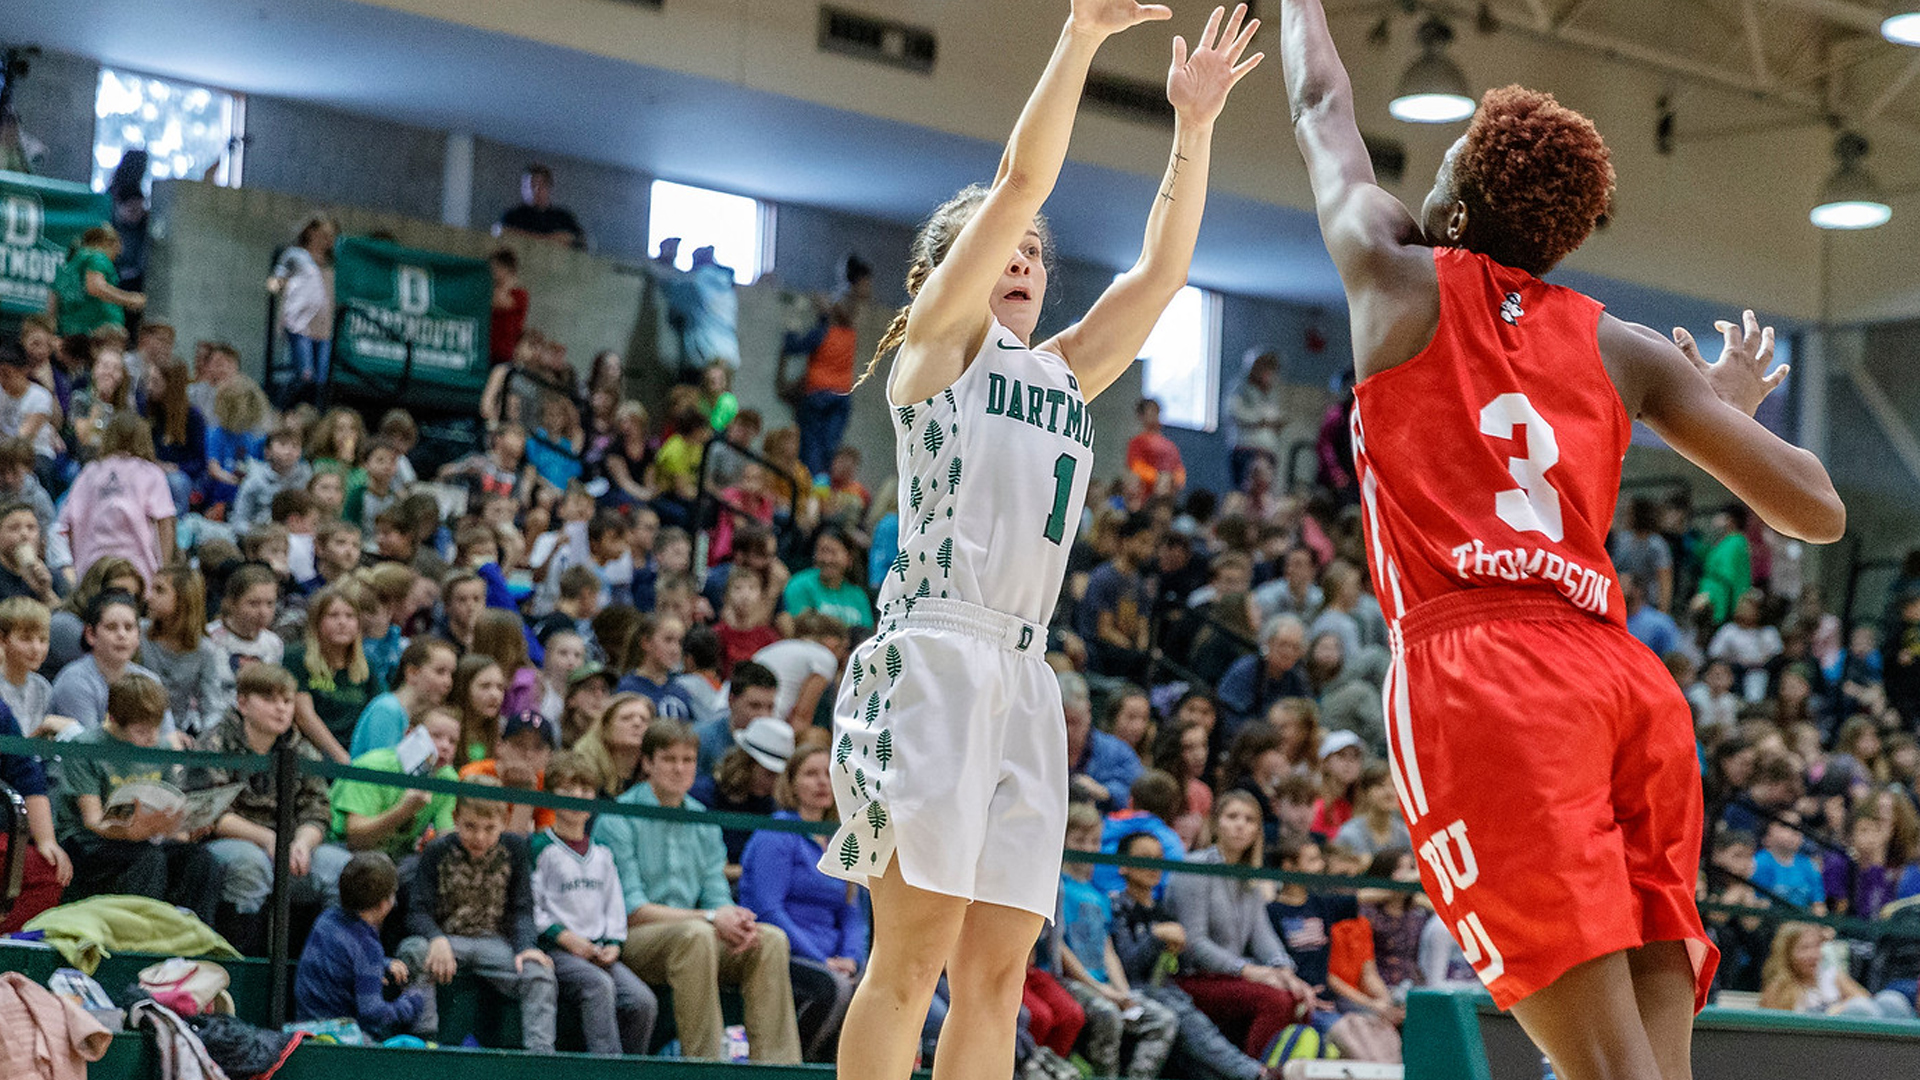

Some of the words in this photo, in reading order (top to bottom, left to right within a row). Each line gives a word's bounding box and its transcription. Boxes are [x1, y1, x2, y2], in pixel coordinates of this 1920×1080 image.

[399, 264, 430, 314] D
[986, 372, 1095, 448] DARTMO
[1043, 452, 1077, 546] 1
[1480, 393, 1564, 543] 3
[1452, 538, 1611, 615] THOMPSON
[1419, 818, 1479, 906] BU
